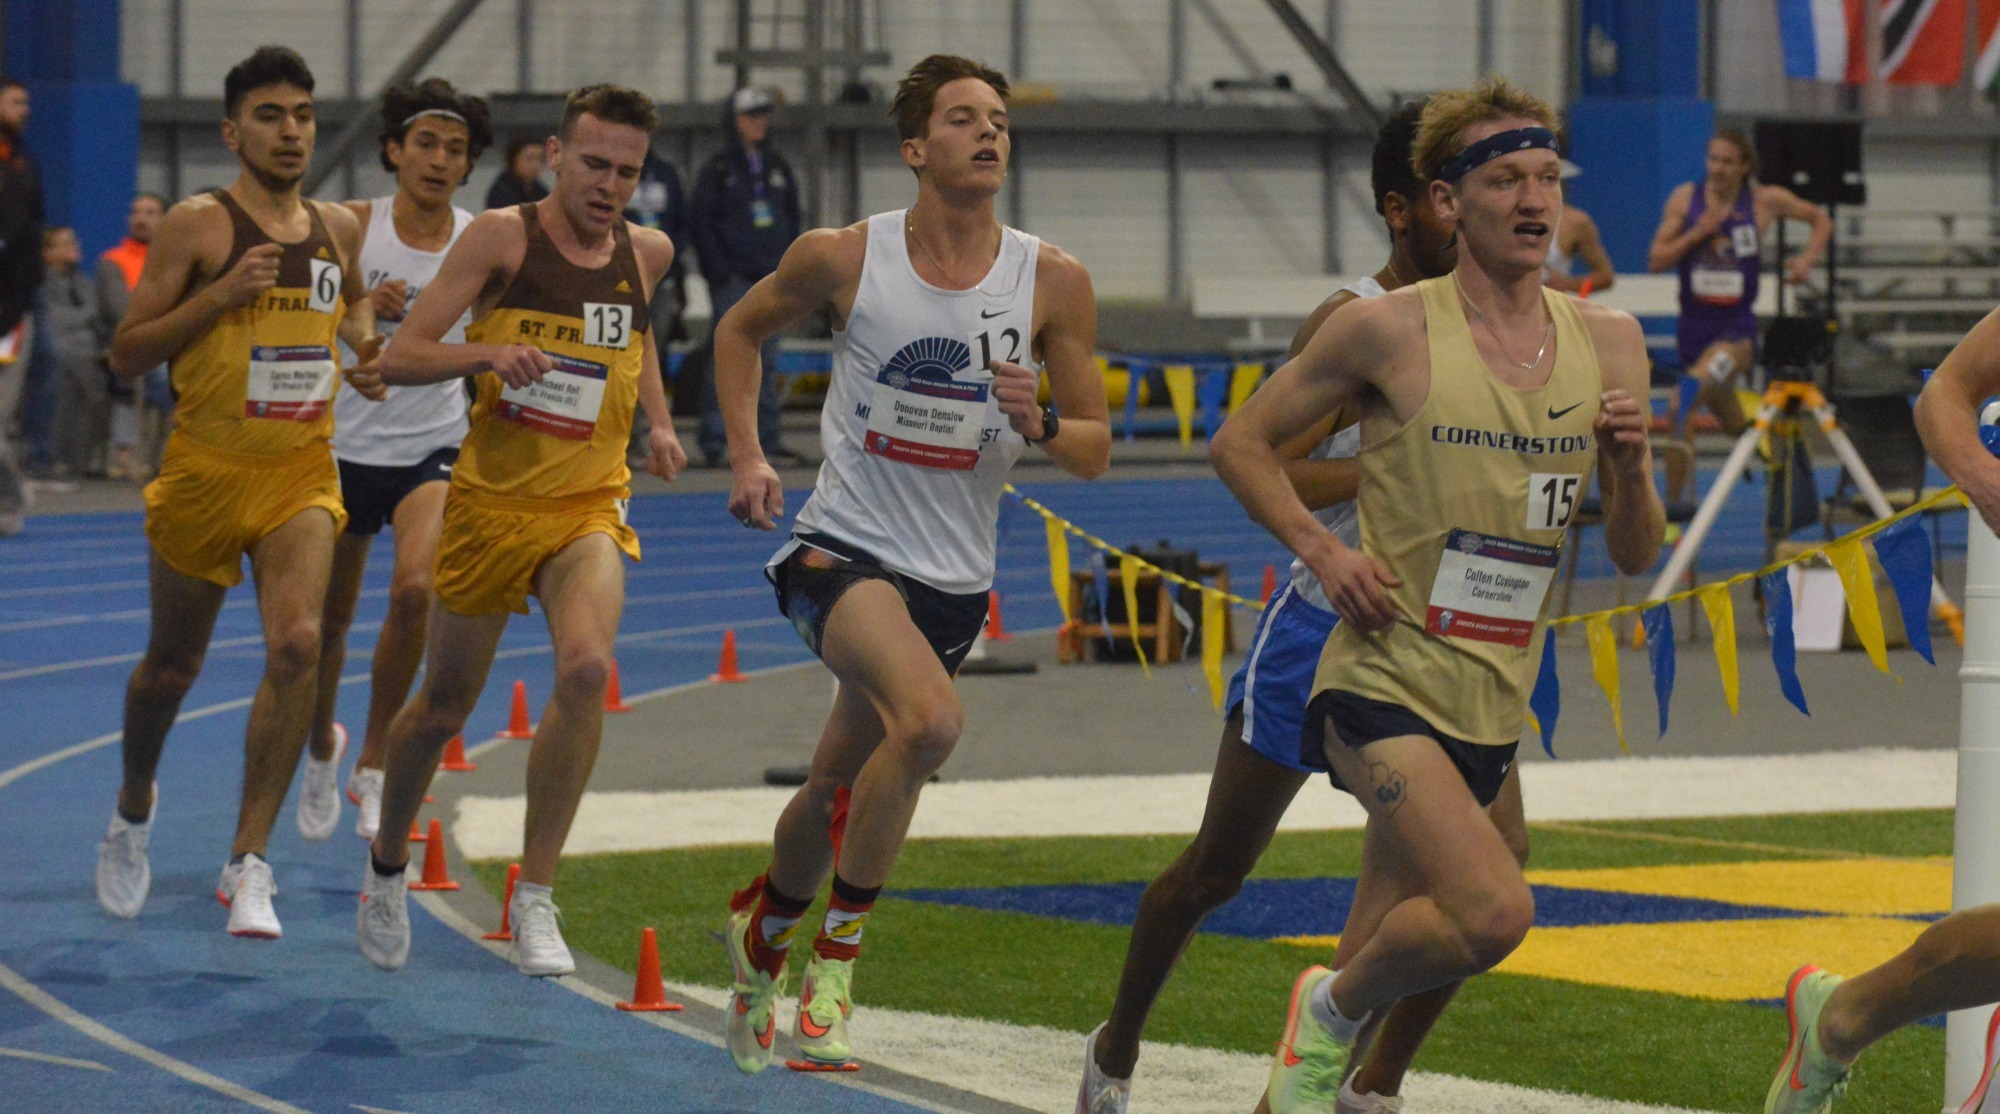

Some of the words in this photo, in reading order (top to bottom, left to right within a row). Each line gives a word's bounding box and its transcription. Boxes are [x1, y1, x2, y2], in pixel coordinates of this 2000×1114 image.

[317, 264, 335, 304] 6
[593, 305, 624, 344] 13
[973, 327, 1022, 372] 12
[894, 399, 929, 418] Donovan
[931, 408, 966, 423] Denslow
[896, 414, 929, 431] Missouri
[929, 422, 956, 435] Baptist
[1431, 425, 1595, 455] CORNERSTON
[1542, 477, 1578, 528] 15
[1471, 586, 1513, 603] Cornerstone
[1494, 573, 1531, 591] Covington
